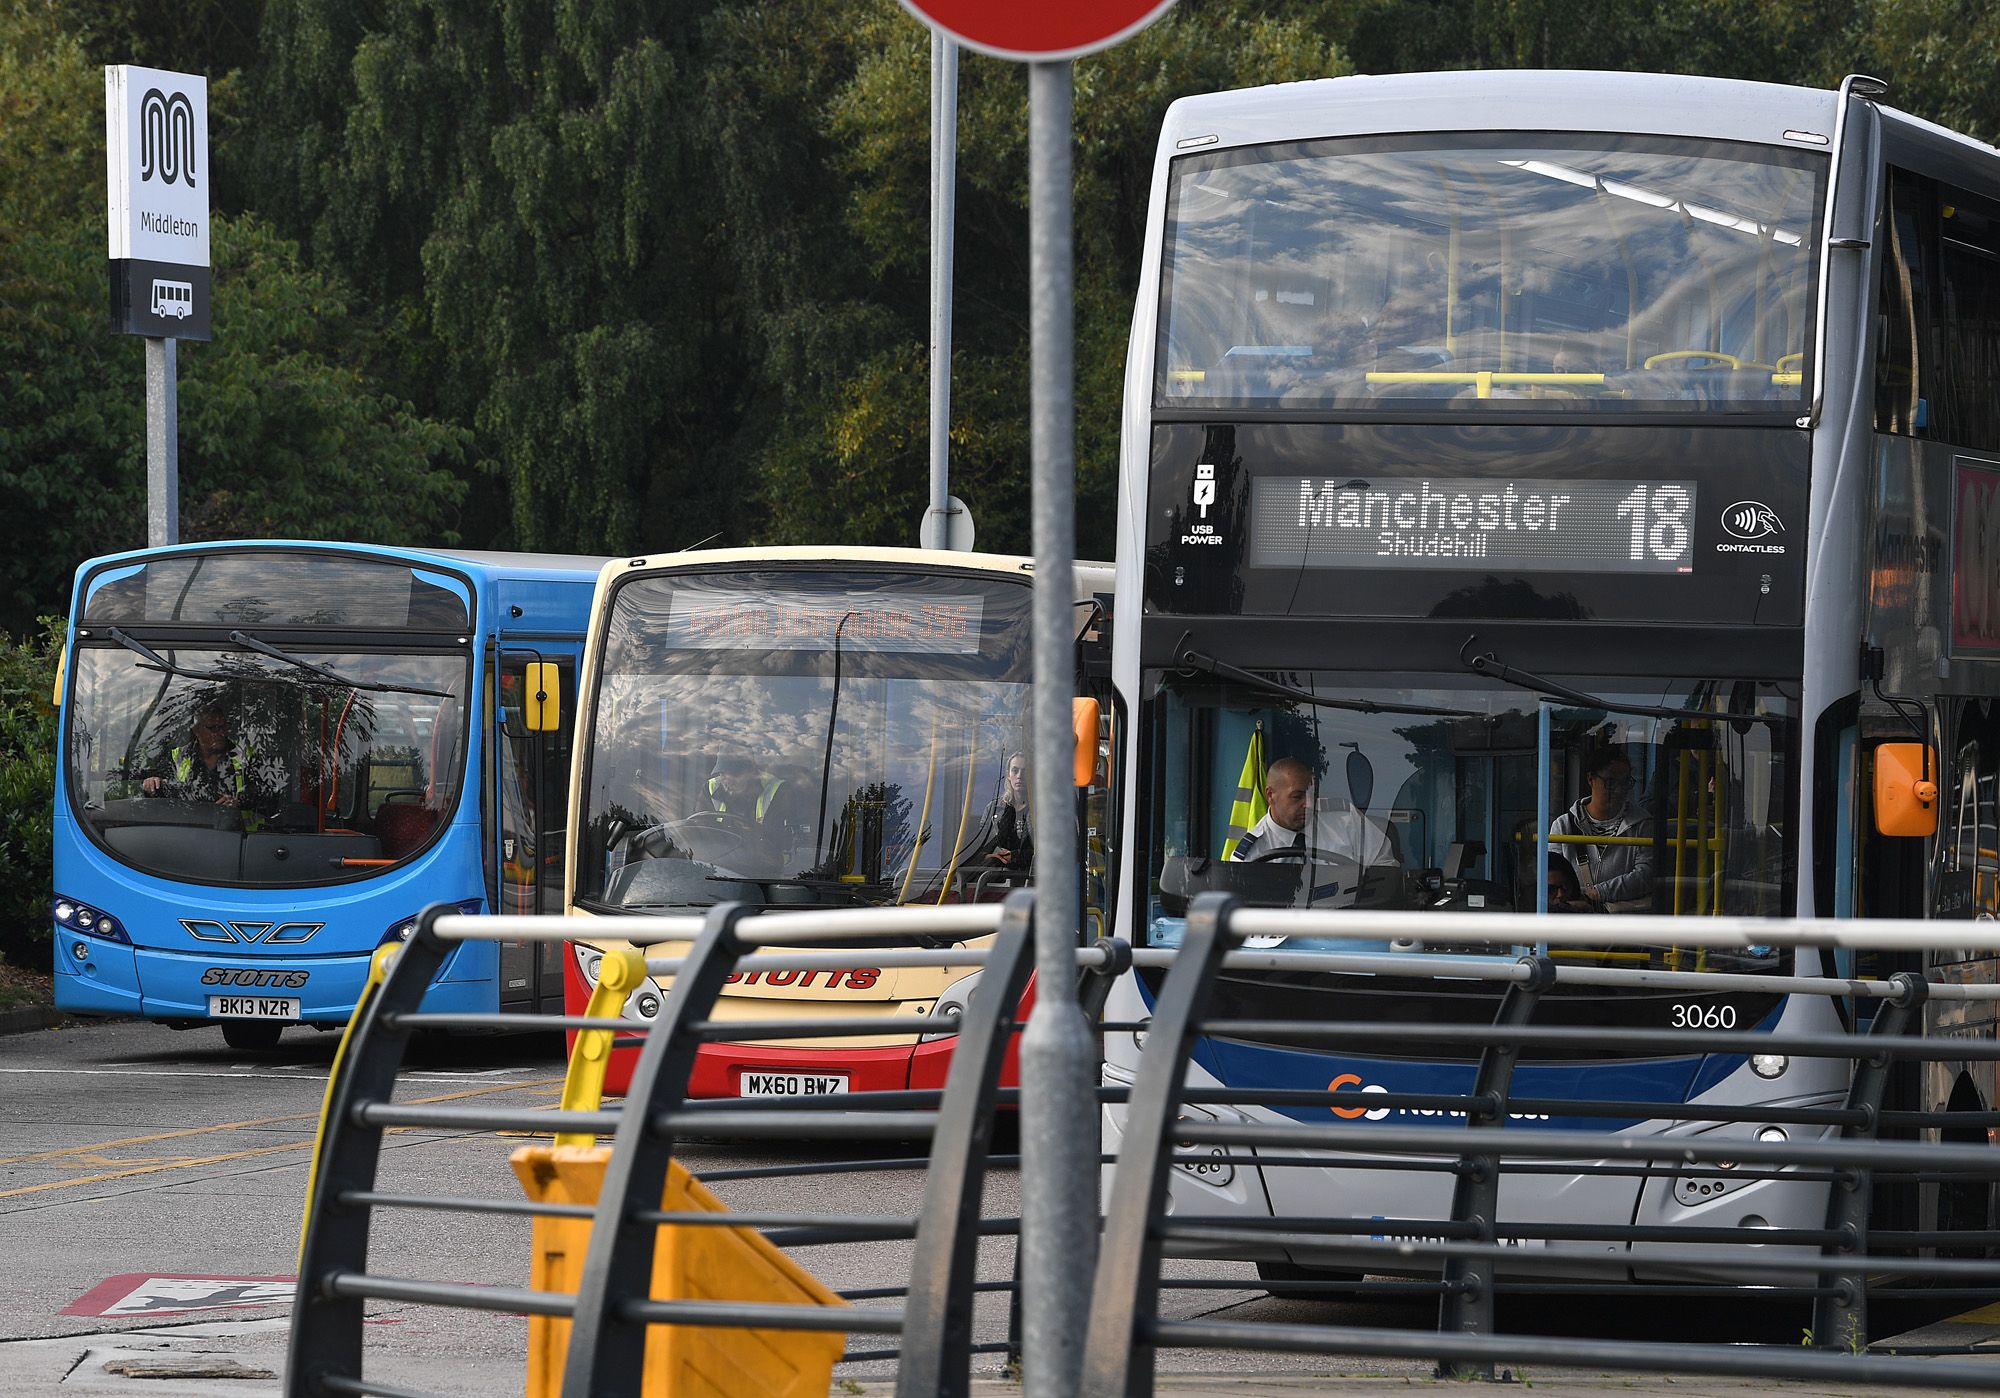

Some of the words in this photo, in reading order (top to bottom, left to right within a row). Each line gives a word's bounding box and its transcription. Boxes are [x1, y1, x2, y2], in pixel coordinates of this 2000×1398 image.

[141, 211, 198, 238] Middleton
[1191, 525, 1214, 534] USB
[1299, 479, 1571, 531] Manchester
[1617, 484, 1690, 561] 18
[1181, 535, 1222, 545] POWER
[1377, 531, 1487, 557] Shudehill
[1716, 544, 1786, 554] CONTACTLESS
[201, 967, 310, 988] STOTTS
[219, 999, 254, 1015] BK13
[258, 1000, 290, 1016] NZR
[1671, 1004, 1736, 1029] 3060
[749, 1076, 797, 1095] MX60
[804, 1078, 840, 1096] BWZ
